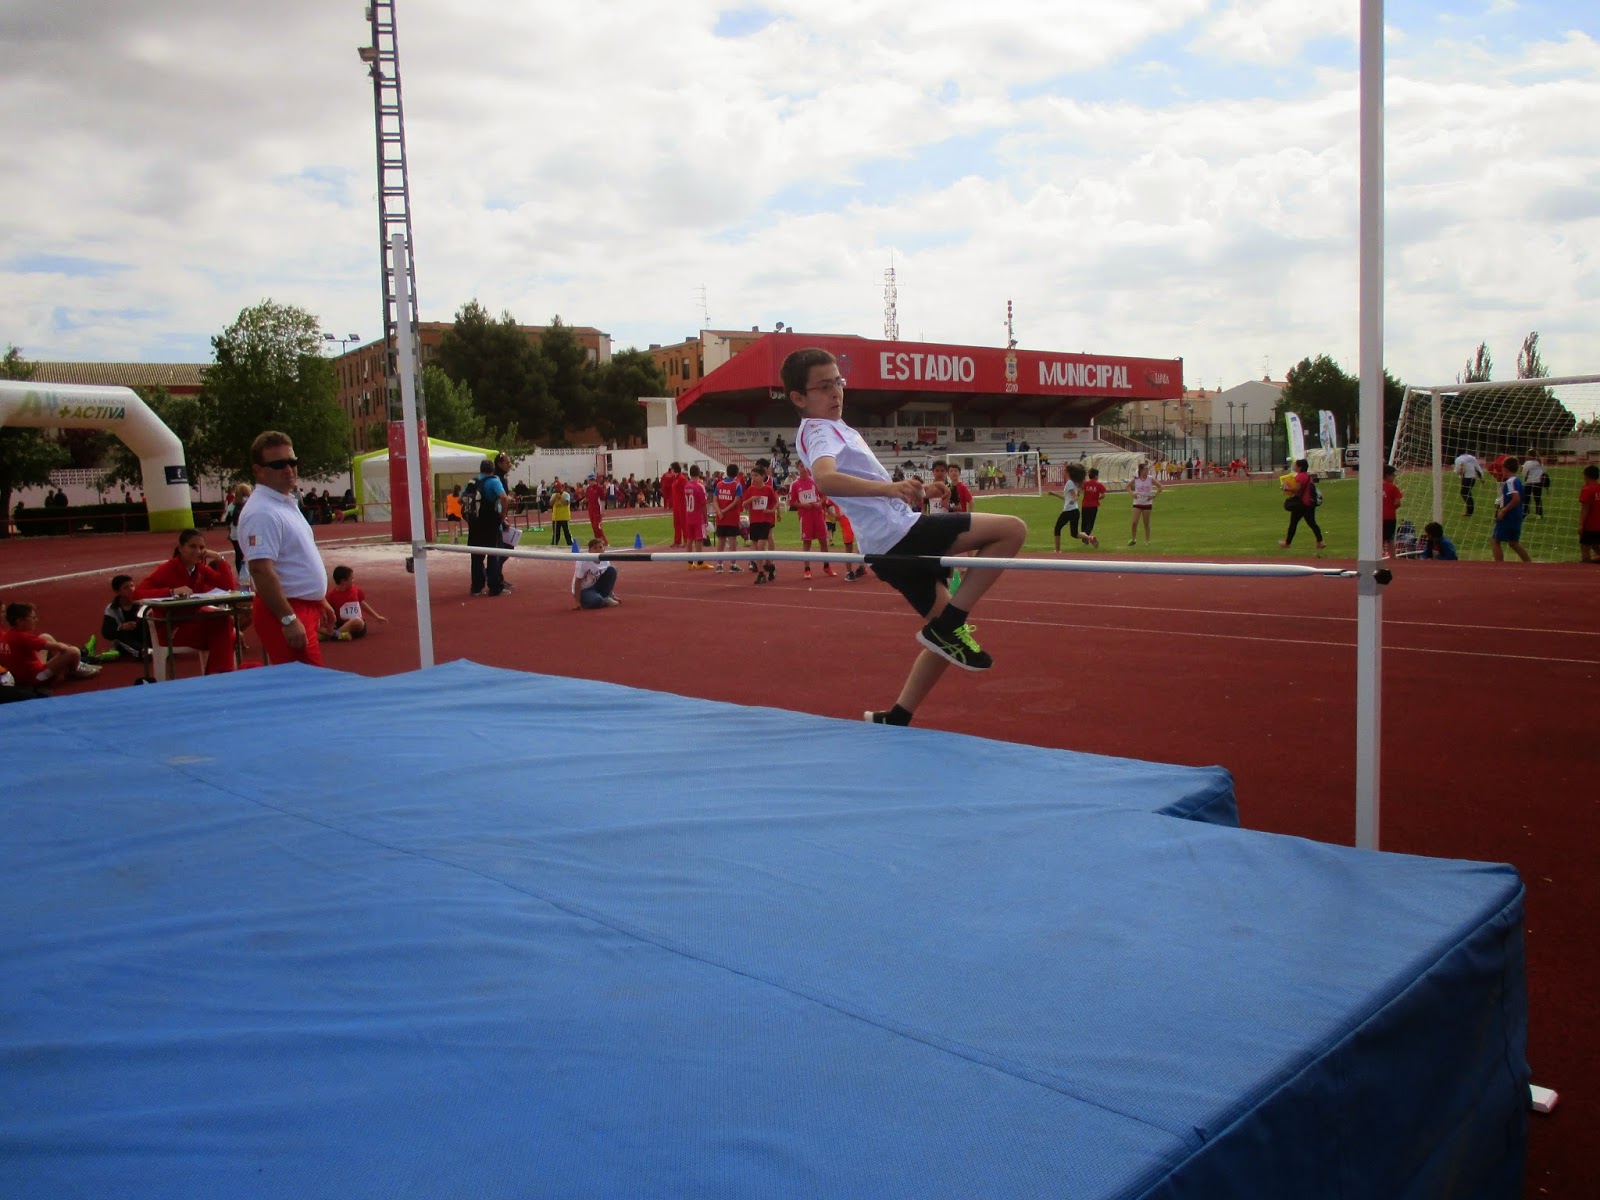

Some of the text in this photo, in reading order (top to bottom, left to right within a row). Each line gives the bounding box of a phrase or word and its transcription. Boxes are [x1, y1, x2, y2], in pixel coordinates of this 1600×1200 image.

[880, 352, 974, 382] ESTADIO
[1039, 361, 1132, 389] MUNICIPAL
[345, 607, 358, 615] 176
